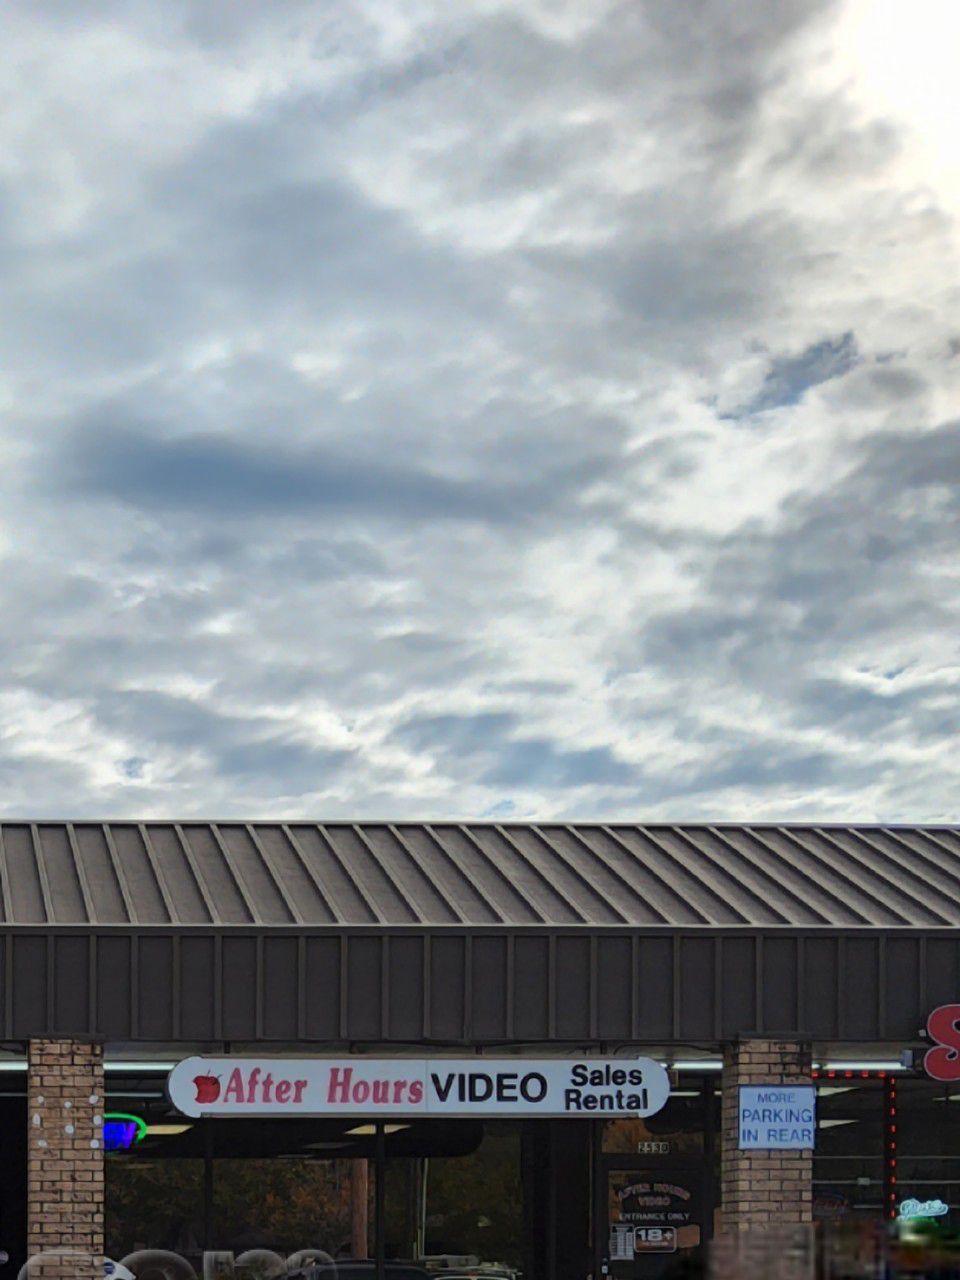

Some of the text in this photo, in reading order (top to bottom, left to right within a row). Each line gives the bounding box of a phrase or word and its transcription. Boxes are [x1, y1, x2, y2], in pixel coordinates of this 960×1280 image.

[570, 1063, 643, 1087] Sales
[224, 1067, 548, 1105] After Hours VIDEO
[564, 1088, 648, 1111] Rental
[757, 1091, 796, 1104] MORE
[742, 1108, 812, 1123] PARKING
[742, 1127, 812, 1142] IN REAR
[637, 1228, 674, 1241] 18+
